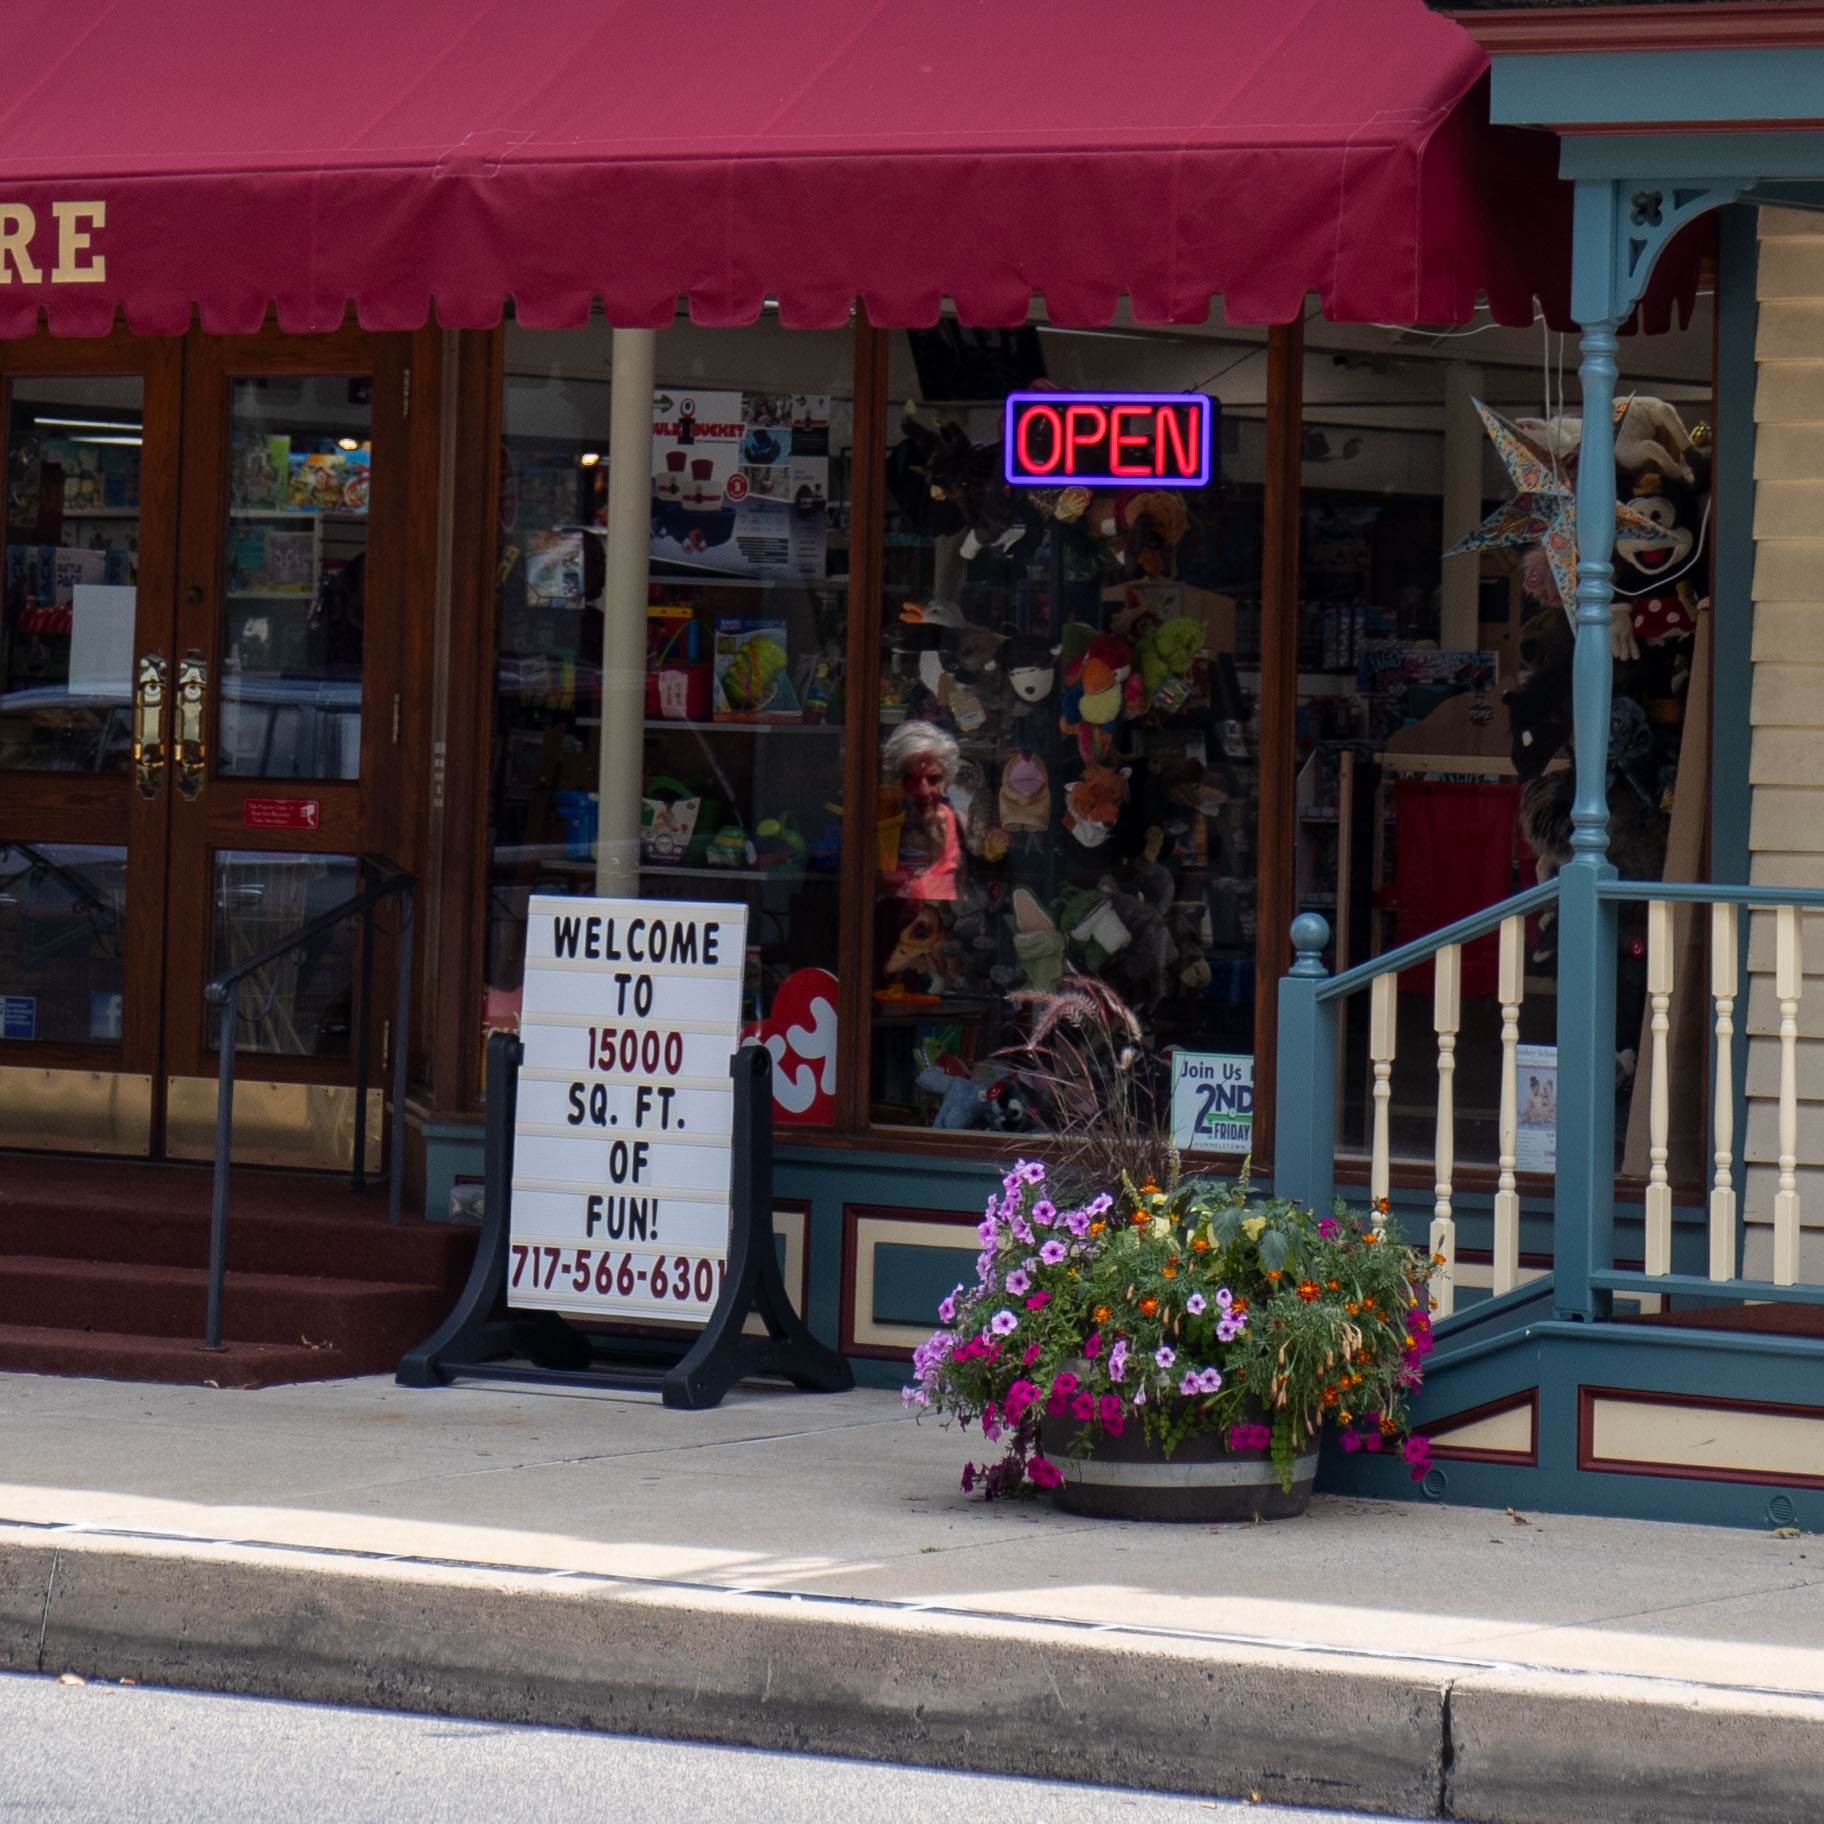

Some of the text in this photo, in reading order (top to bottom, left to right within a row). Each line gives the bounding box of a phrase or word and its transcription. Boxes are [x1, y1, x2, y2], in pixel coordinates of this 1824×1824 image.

[1017, 405, 1199, 477] OPEN
[553, 915, 721, 965] WELCOME
[613, 973, 653, 1017] TO
[588, 1027, 684, 1075] 15000
[1181, 1061, 1214, 1079] Join
[1223, 1063, 1242, 1080] Us
[568, 1081, 686, 1131] SQ. FT.
[1195, 1083, 1253, 1134] 2ND
[1214, 1123, 1250, 1141] FRIDAY
[608, 1140, 650, 1184] OF
[585, 1194, 659, 1241] FUN!
